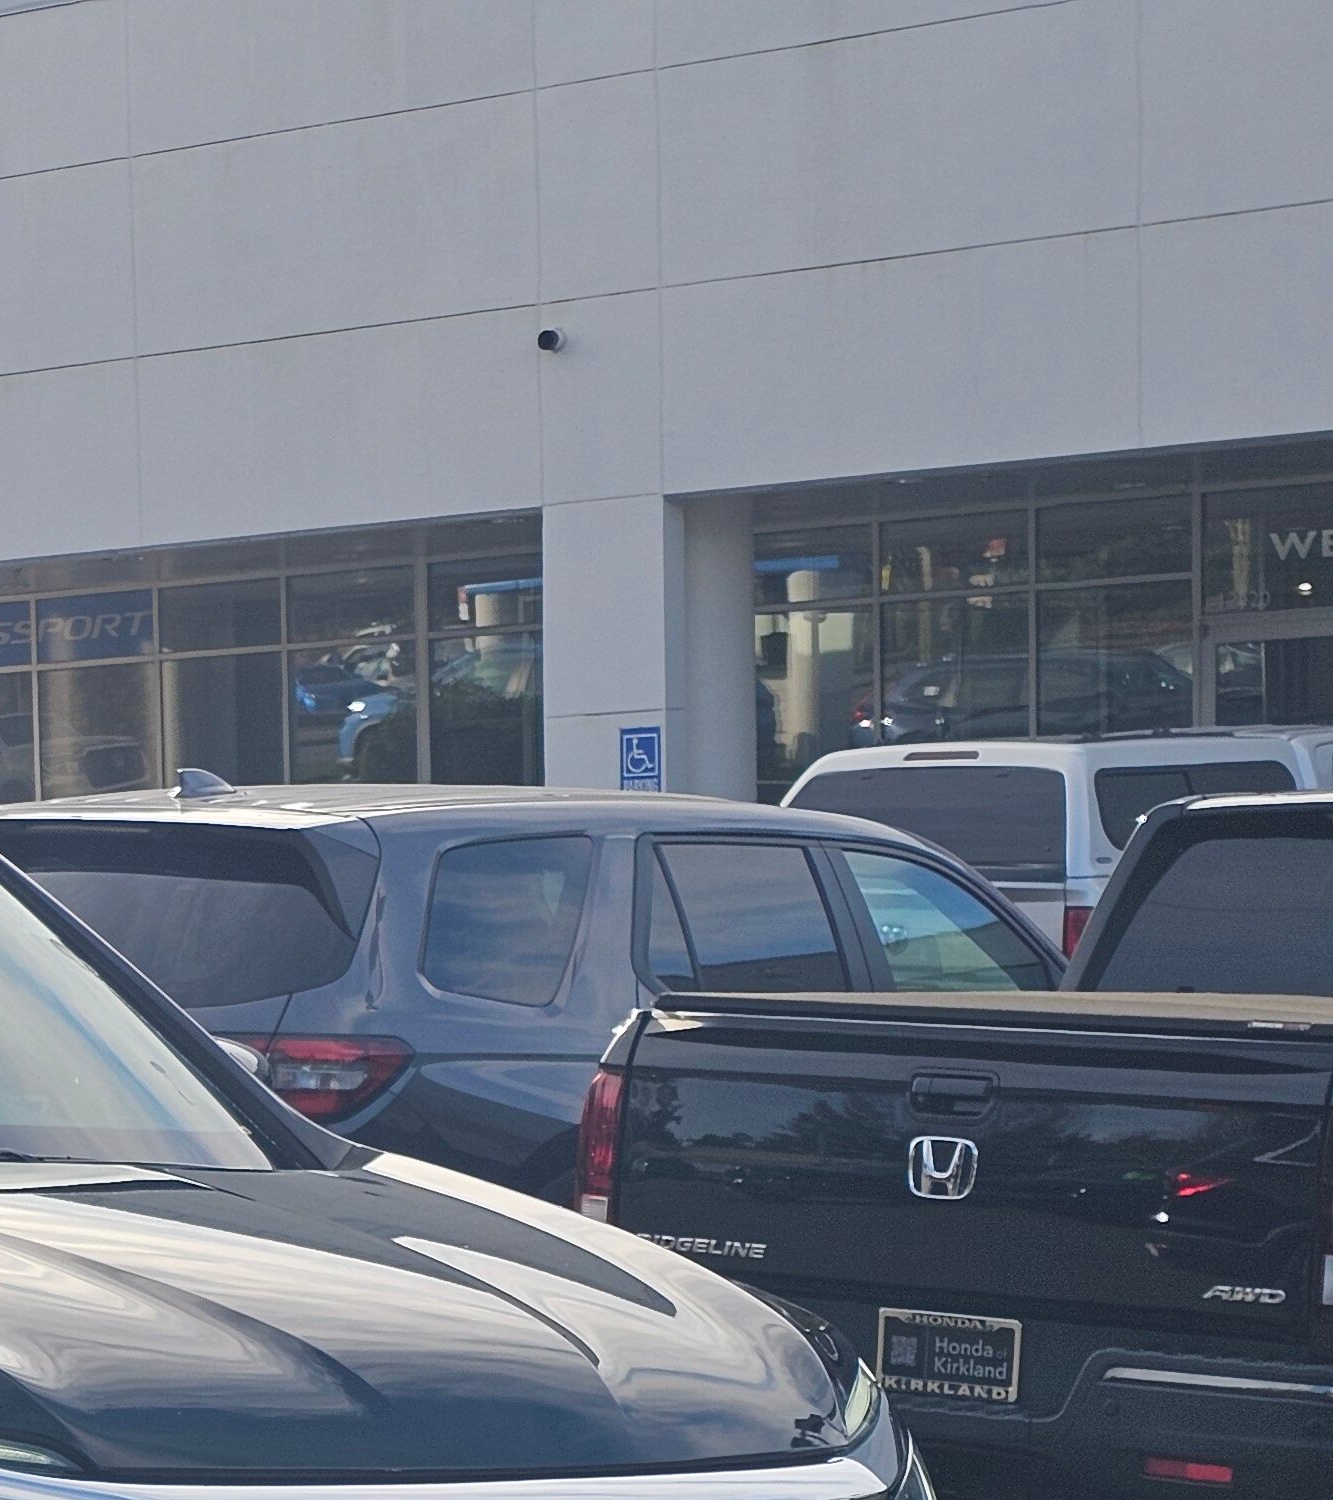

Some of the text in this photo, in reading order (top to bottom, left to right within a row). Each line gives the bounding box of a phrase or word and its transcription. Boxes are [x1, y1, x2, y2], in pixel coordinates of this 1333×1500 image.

[1202, 1284, 1286, 1304] AWD
[914, 1314, 983, 1330] HONDA
[934, 1336, 1008, 1359] Honda of
[933, 1356, 1008, 1380] Kirkland
[884, 1375, 1007, 1400] KIRKLAND
